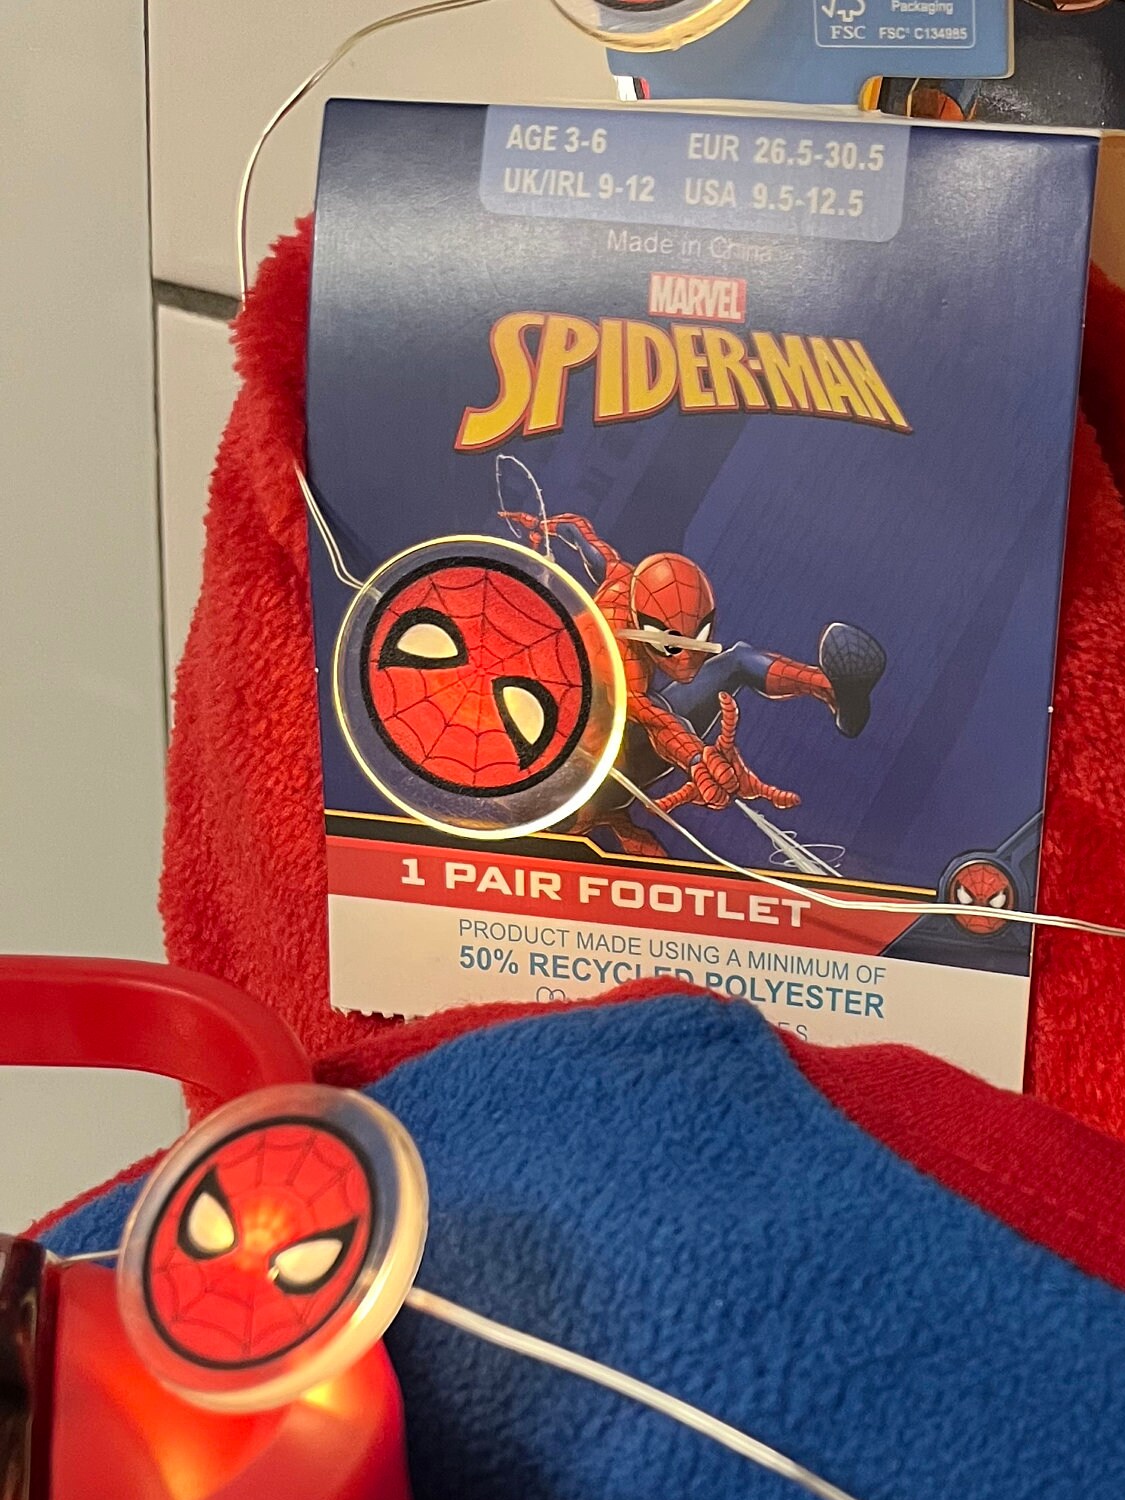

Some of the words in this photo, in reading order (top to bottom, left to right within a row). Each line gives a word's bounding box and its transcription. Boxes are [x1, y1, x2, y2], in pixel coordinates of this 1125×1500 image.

[891, 0, 954, 15] Packaging
[830, 25, 867, 40] FSC
[506, 124, 557, 153] AGE
[563, 127, 608, 154] 3-6
[688, 133, 740, 162] EUR
[753, 137, 885, 171] 26.5-30.5
[504, 168, 591, 199] UK/IRL
[599, 175, 655, 202] 9-12
[685, 177, 736, 207] USA
[753, 183, 864, 217] 9.5-12.5
[607, 229, 674, 255] Made
[681, 233, 702, 256] in
[708, 235, 773, 263] China
[650, 274, 744, 320] MARVEL
[454, 312, 912, 450] SPIDER-MAN
[401, 858, 426, 886] 1
[445, 863, 563, 902] PAIR
[579, 876, 812, 927] FOOTLET
[459, 918, 570, 948] PRODUCT
[577, 931, 642, 956] MADE
[649, 939, 720, 964] USING
[726, 949, 741, 967] A
[748, 951, 849, 981] MINIMUM
[856, 965, 887, 985] OF
[459, 945, 519, 975] 50%
[706, 972, 884, 1018] POLYESTER
